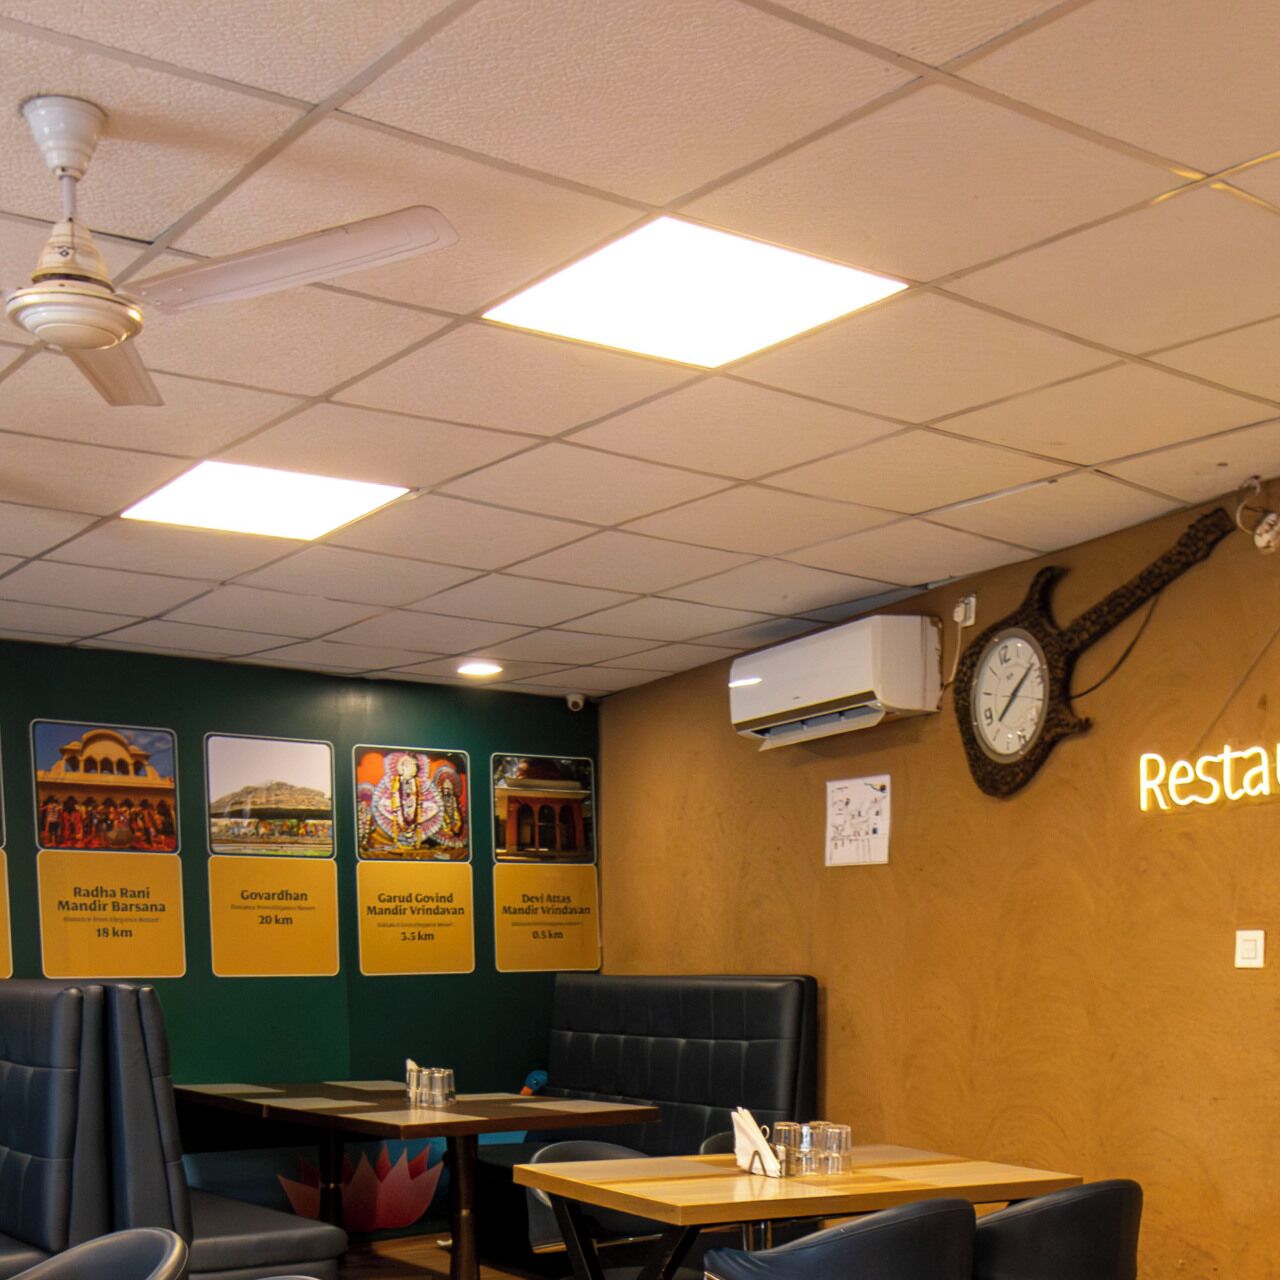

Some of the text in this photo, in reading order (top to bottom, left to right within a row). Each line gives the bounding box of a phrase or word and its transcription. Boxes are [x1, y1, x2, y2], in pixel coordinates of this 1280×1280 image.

[73, 886, 151, 899] Radha Rani
[240, 889, 309, 901] Govardhan
[378, 892, 454, 903] Garud Govind
[57, 900, 167, 913] Mandir Barsana
[366, 904, 466, 916] Mandir Vrindavan
[502, 905, 539, 915] Mandir
[258, 914, 294, 925] 20 km
[96, 926, 134, 938] 18 km
[417, 930, 435, 941] km
[548, 929, 564, 939] km
